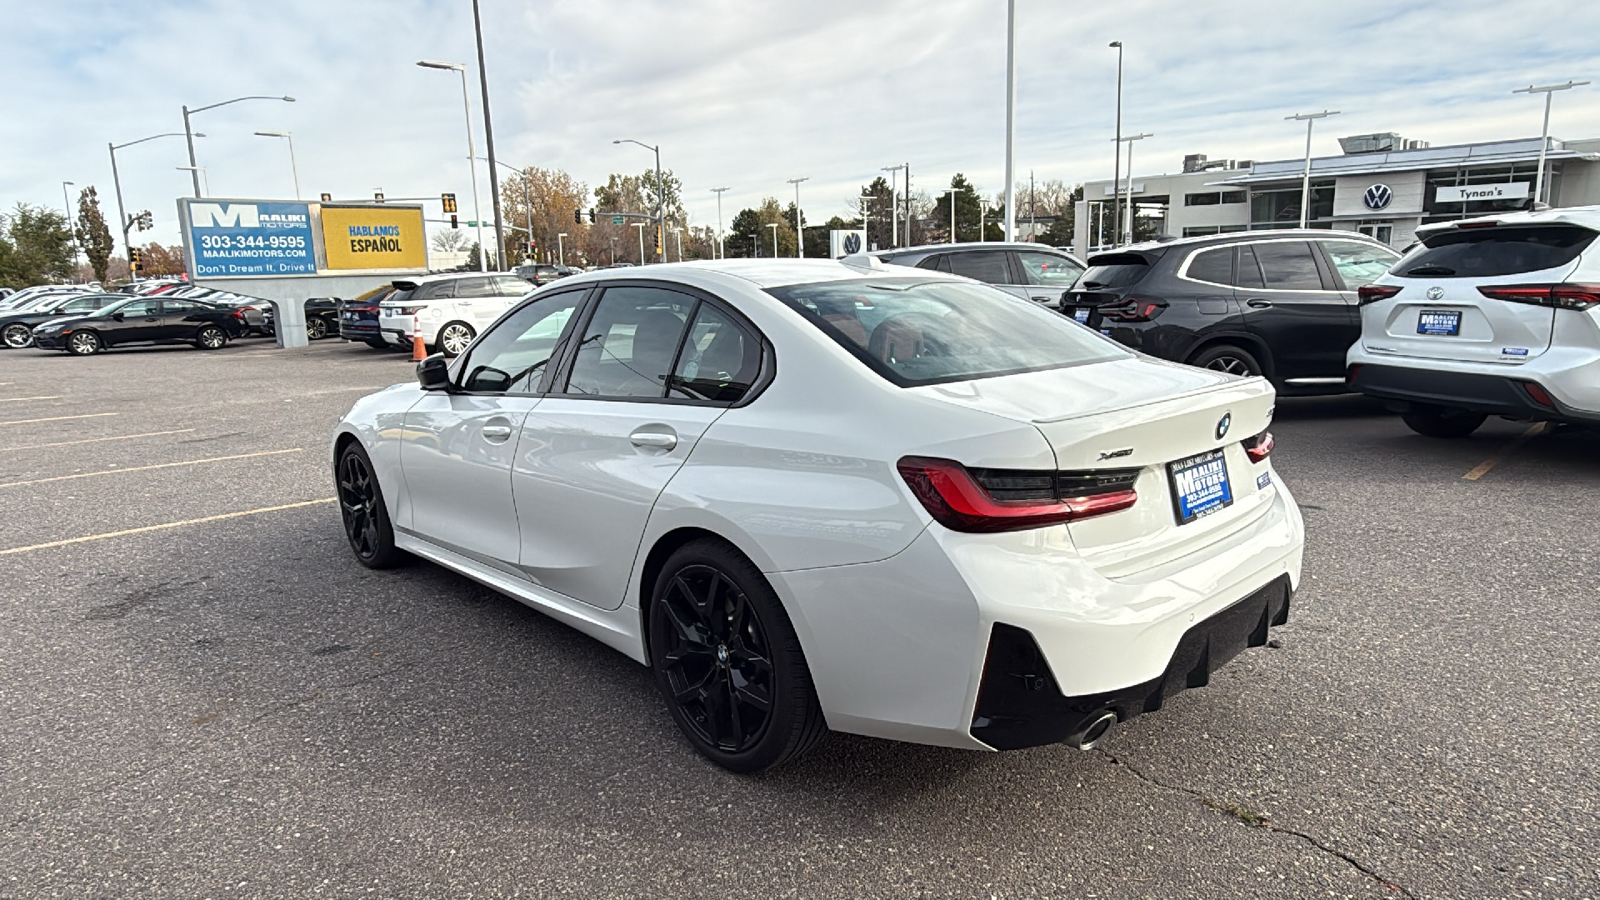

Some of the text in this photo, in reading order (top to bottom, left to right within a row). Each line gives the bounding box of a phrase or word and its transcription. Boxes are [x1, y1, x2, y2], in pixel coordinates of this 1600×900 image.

[1460, 188, 1503, 199] Tynan's
[190, 203, 306, 227] MAALIKI
[348, 225, 400, 236] HABLAMOS
[201, 235, 305, 248] 303-344-9595
[351, 238, 402, 252] ESPAÑOL
[203, 249, 306, 258] MAALIKIMOTORS.COM
[198, 265, 226, 273] Don't
[229, 264, 263, 272] Dream
[280, 263, 305, 271] Drive
[308, 263, 315, 271] It
